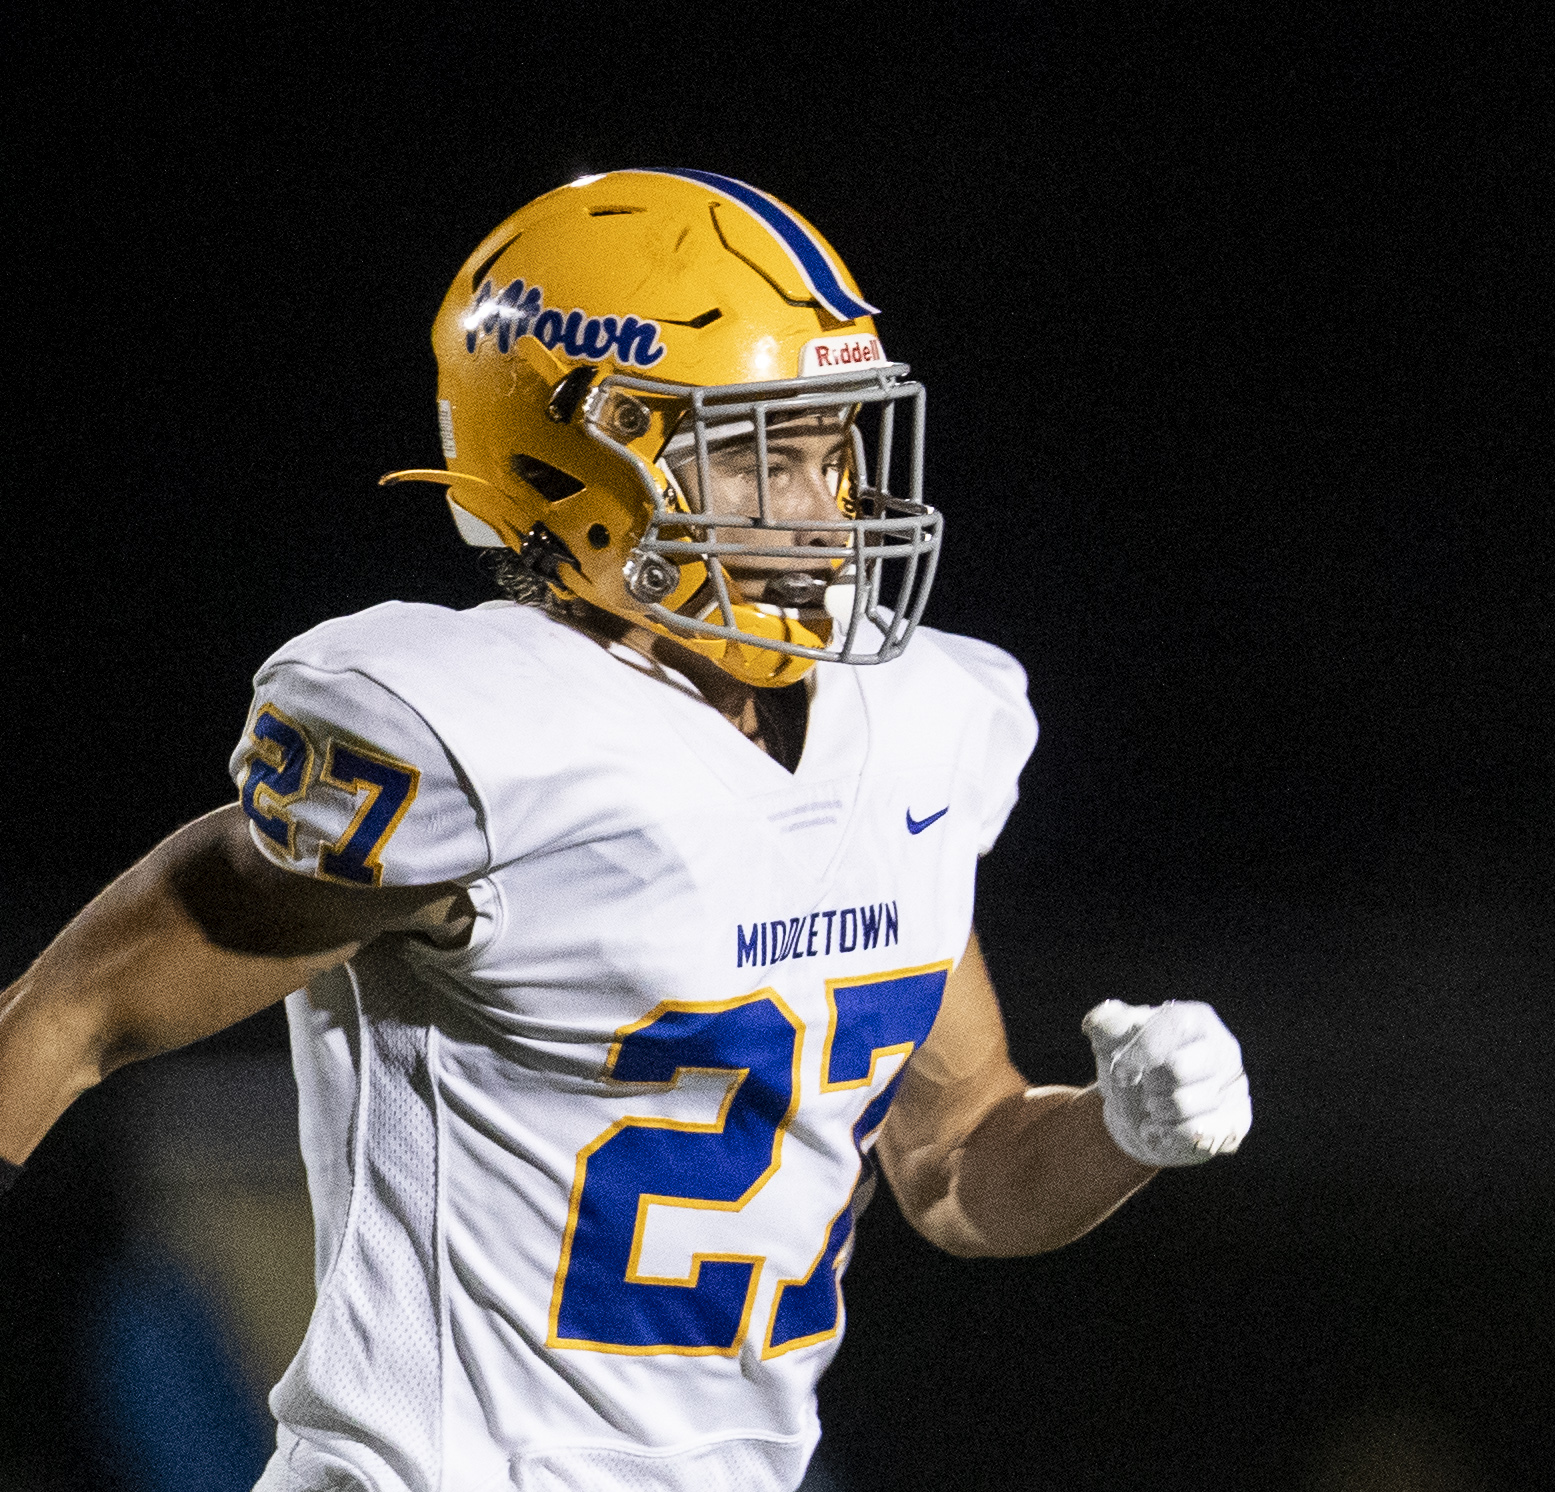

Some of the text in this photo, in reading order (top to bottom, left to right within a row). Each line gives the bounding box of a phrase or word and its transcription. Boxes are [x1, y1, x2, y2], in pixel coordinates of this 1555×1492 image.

[815, 340, 880, 367] Riddell
[239, 701, 421, 887] 27
[737, 900, 898, 968] MIDDLETOWN
[546, 958, 954, 1362] 27
